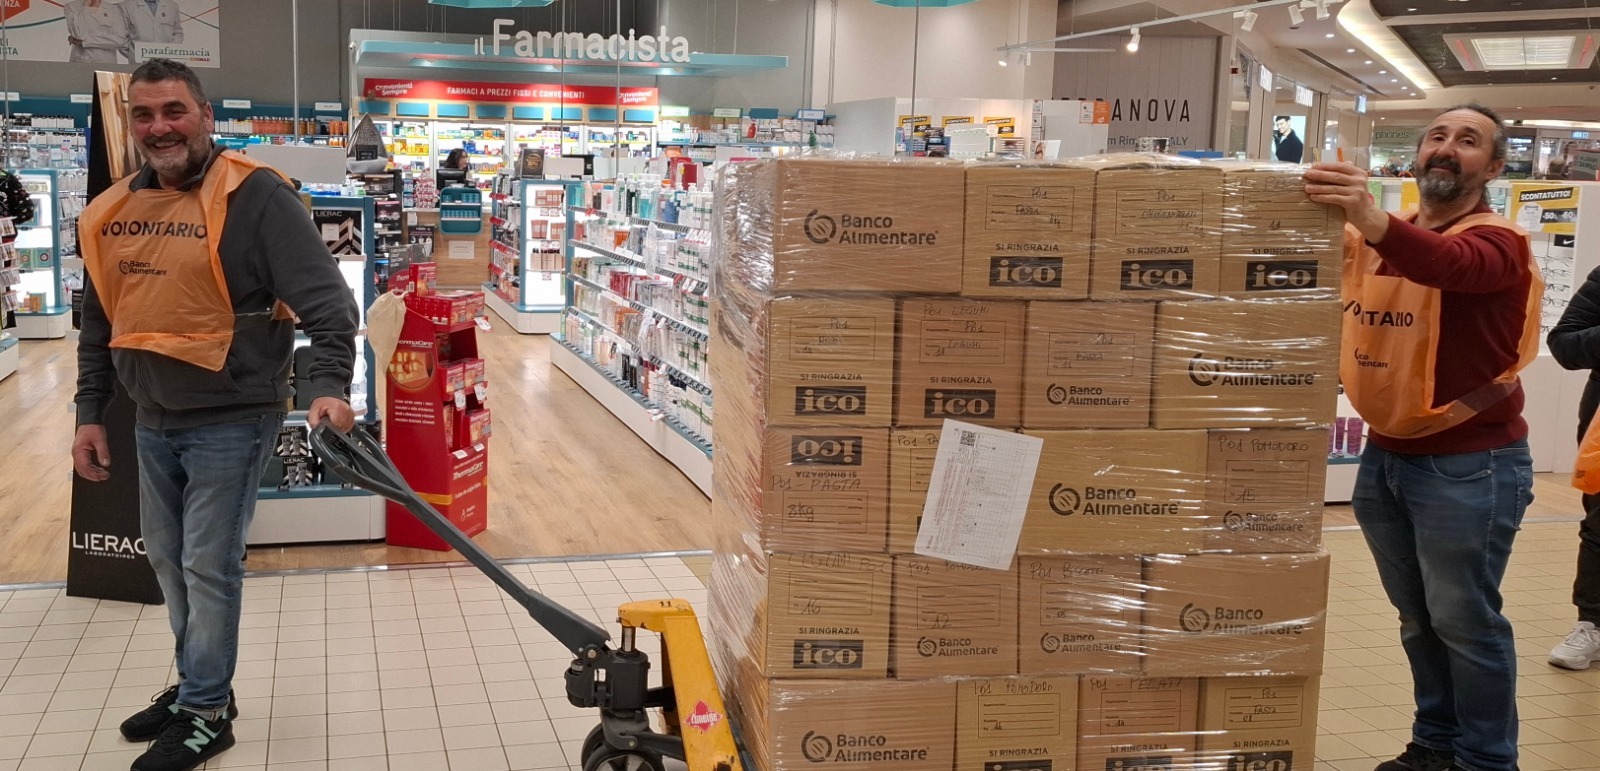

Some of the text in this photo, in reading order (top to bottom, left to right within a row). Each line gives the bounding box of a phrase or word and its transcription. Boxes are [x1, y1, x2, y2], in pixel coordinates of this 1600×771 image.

[474, 18, 690, 63] il Farmacista
[141, 46, 210, 57] parafarmacia
[381, 88, 408, 96] Sempre
[447, 87, 478, 95] FARMACI
[487, 88, 511, 96] PREZZI
[513, 89, 531, 97] FISSI
[539, 90, 585, 98] CONVENIENTI
[1521, 190, 1571, 200] SCONTATUTTO!
[841, 214, 893, 228] Banco
[101, 221, 208, 239] VOLONTARIO
[839, 231, 938, 245] Alimentare
[996, 243, 1060, 252] SI RINGRAZIA
[1126, 246, 1190, 255] SI RINGRAZIA
[996, 259, 1056, 284] ico
[1127, 263, 1187, 286] ico
[1252, 264, 1311, 287] ico
[1224, 356, 1274, 370] Banco
[1222, 372, 1314, 386] Alimentare
[1069, 386, 1102, 395] Banco
[802, 389, 860, 412] ico
[931, 392, 990, 415] ico
[1068, 396, 1130, 406] Alimentare
[798, 440, 856, 463] ico
[1085, 487, 1136, 500] Banco
[1083, 502, 1179, 515] Alimentare
[1246, 512, 1278, 522] Banco
[1243, 522, 1304, 532] Alimentare
[72, 531, 147, 555] LIERAC
[85, 550, 135, 559] LABORATOIRES
[1214, 607, 1263, 620] Banco
[1213, 622, 1303, 635] Alimentare
[939, 637, 972, 647] Banco
[1063, 633, 1095, 643] Banco
[800, 642, 858, 665] ico
[938, 646, 998, 657] Alimentare
[1061, 643, 1121, 653] Alimentare
[836, 734, 886, 747] Banco
[1233, 739, 1290, 748] SI RINGRAZIA
[834, 747, 928, 762] Alimentare
[1000, 747, 1048, 756] RINGRAZIA
[1121, 744, 1168, 752] RINGRAZIA
